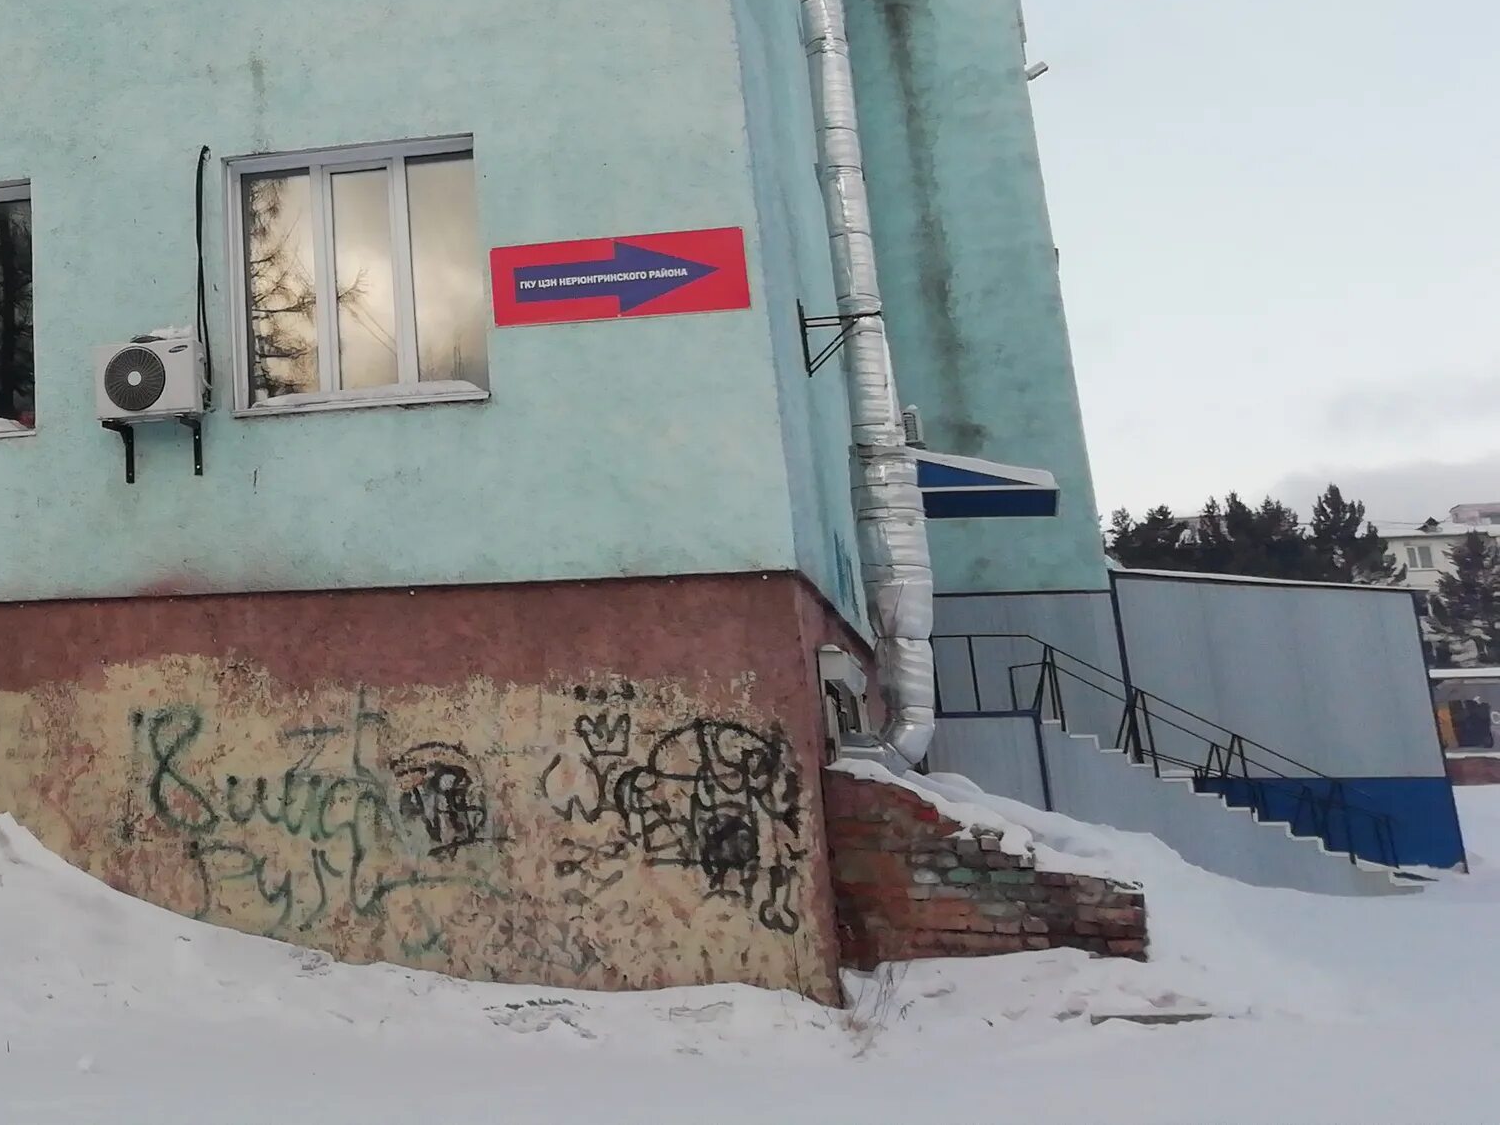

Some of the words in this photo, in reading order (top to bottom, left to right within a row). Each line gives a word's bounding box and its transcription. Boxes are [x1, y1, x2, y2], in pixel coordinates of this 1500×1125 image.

[519, 280, 536, 290] ГКУ
[538, 279, 557, 289] ЦЗН
[559, 271, 647, 287] НЕРЮНГРИНСКОГО
[648, 267, 688, 279] РАЙОНА
